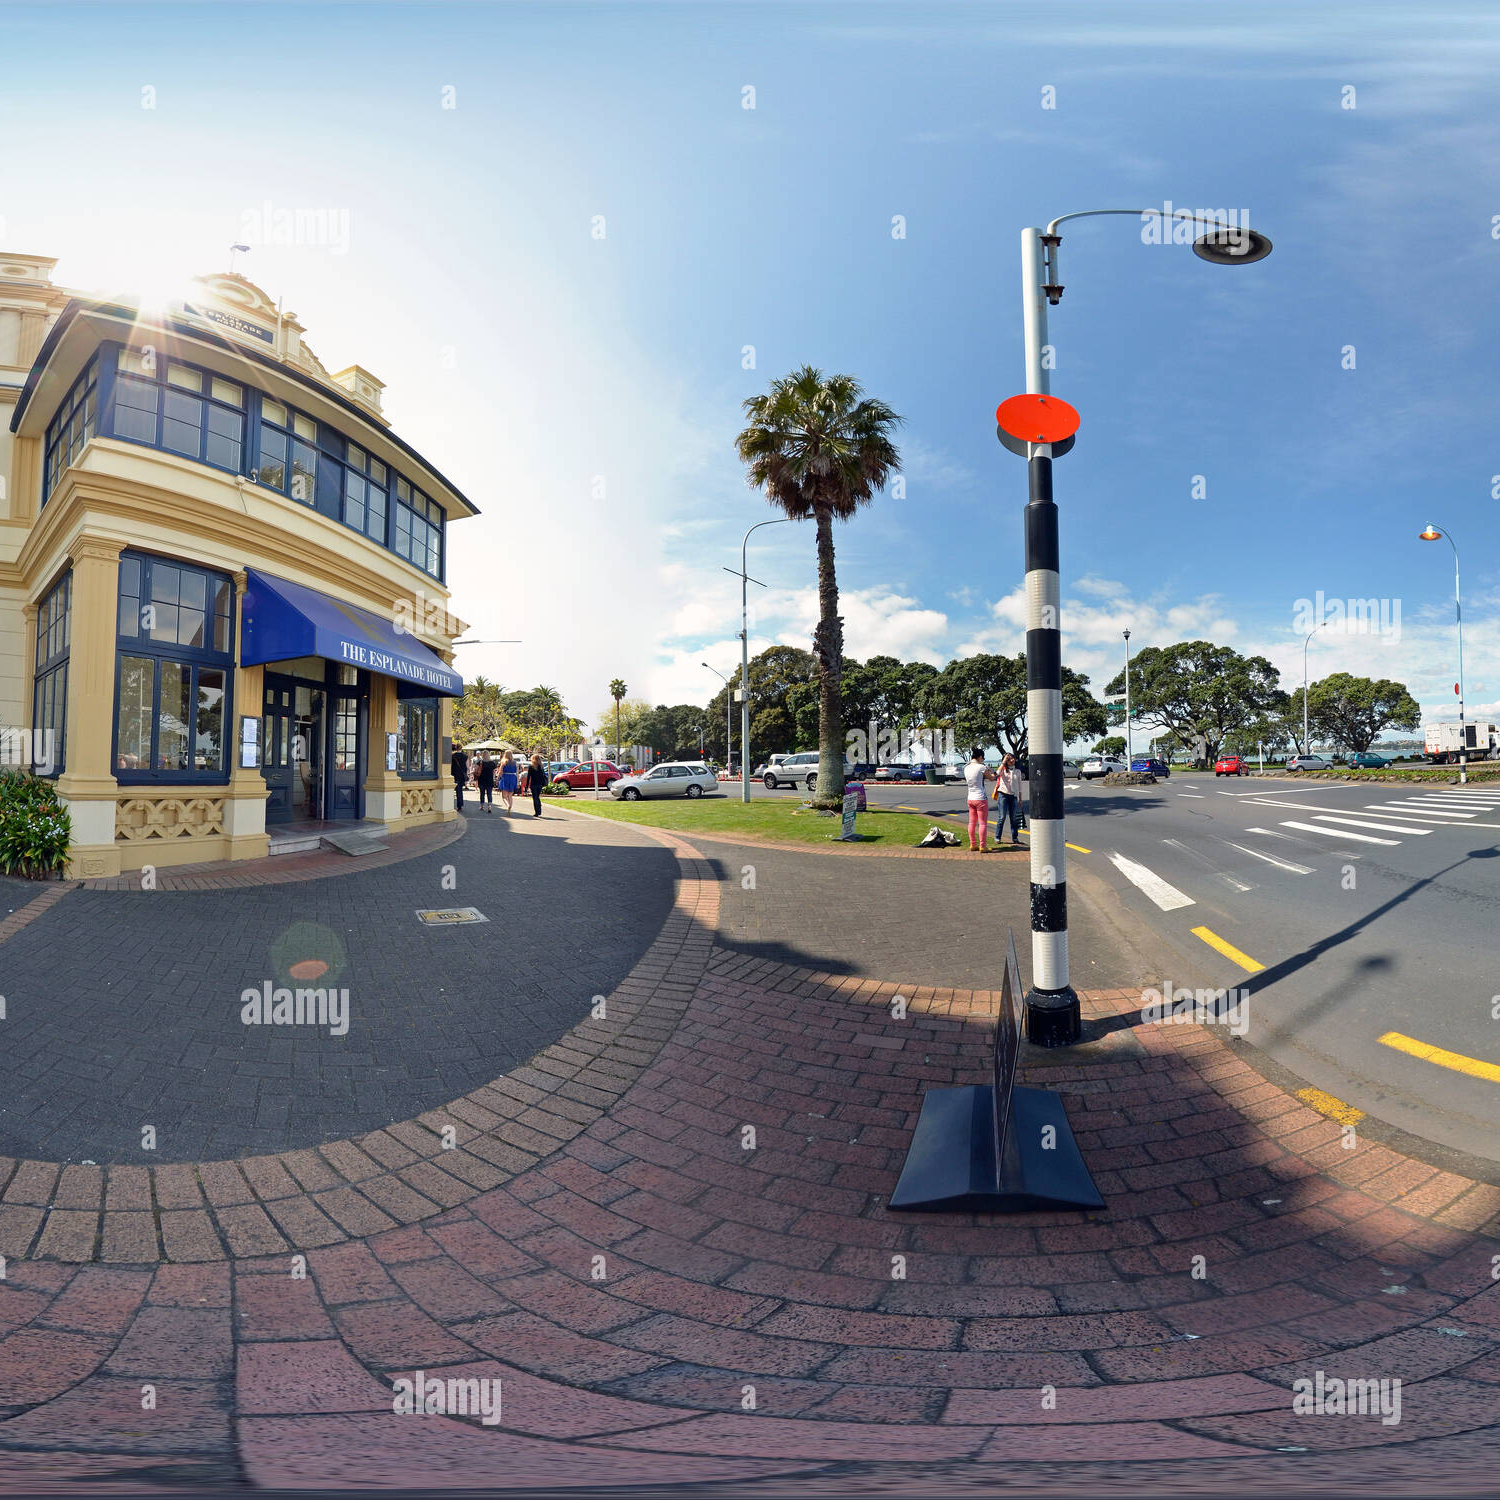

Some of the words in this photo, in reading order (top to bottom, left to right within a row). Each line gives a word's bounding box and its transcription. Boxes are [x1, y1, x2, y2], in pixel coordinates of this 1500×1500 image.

[206, 310, 263, 336] SPLANADE
[341, 641, 367, 663] THE
[369, 650, 425, 681] ESPLANADE
[426, 669, 453, 690] HOTEL
